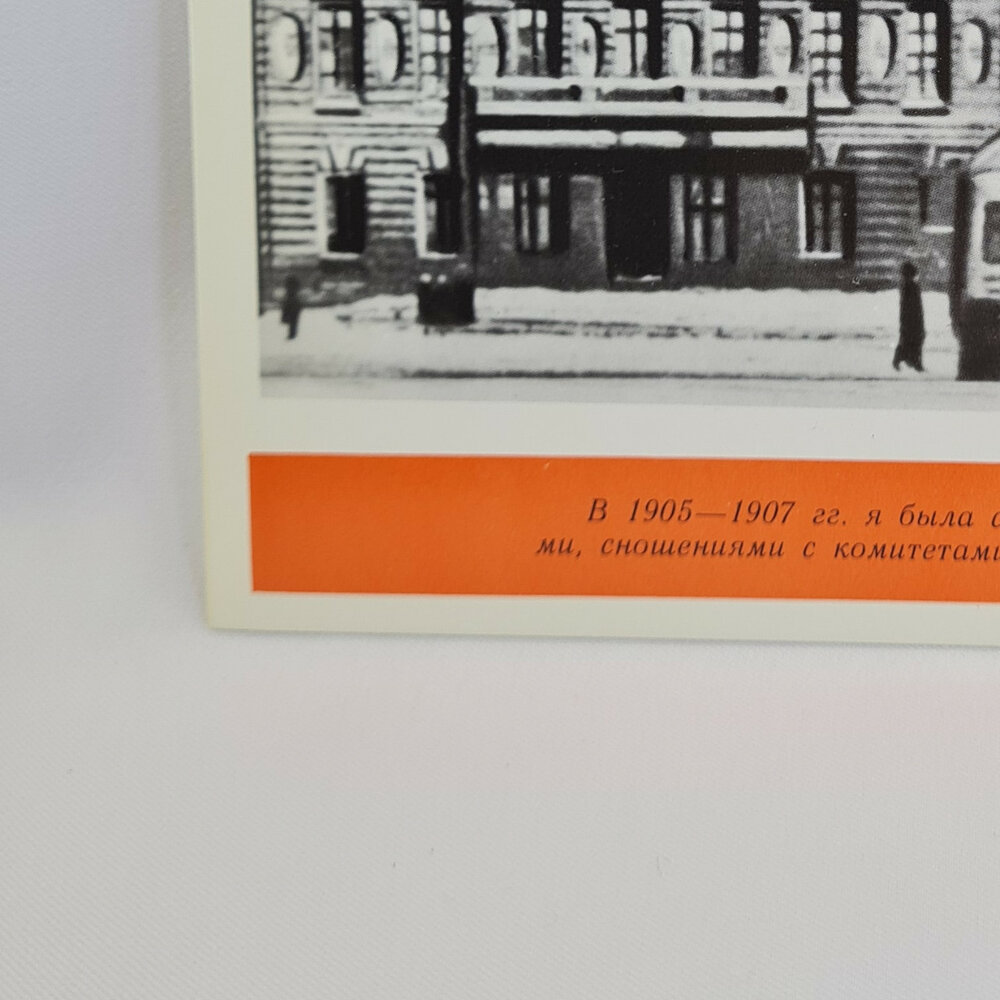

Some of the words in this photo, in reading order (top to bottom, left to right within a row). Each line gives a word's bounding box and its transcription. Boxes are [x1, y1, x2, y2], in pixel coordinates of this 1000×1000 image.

[587, 497, 608, 523] В
[812, 507, 848, 527] гг.
[864, 508, 882, 527] я
[899, 503, 974, 529] была
[535, 537, 582, 559] ми,
[600, 536, 785, 559] сношениями
[801, 541, 817, 559] с
